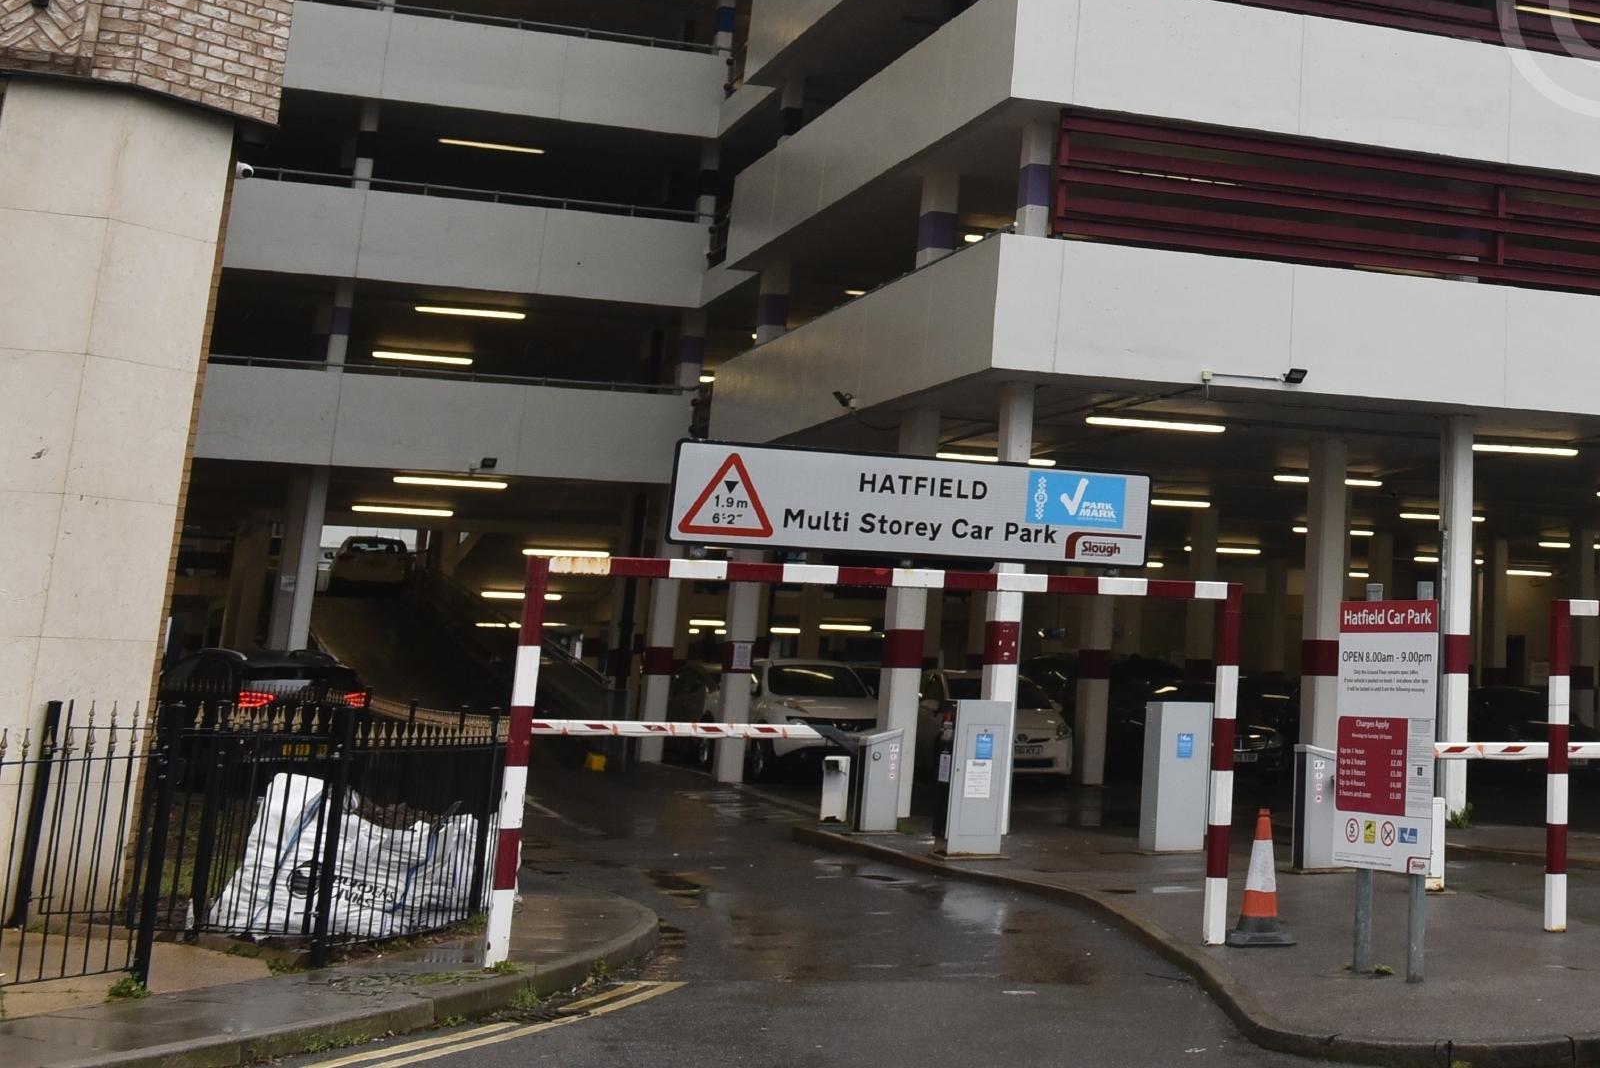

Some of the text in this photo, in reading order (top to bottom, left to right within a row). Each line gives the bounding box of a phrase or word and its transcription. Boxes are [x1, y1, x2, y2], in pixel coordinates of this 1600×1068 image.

[859, 472, 988, 500] HATFIELD
[1079, 508, 1116, 518] MARK
[1082, 502, 1113, 510] PARK
[783, 508, 1058, 544] Multi Storey Car Park
[1082, 540, 1120, 557] Slough
[1344, 608, 1432, 626] Hatfield Car Park
[1342, 651, 1364, 662] OPEN
[1366, 652, 1394, 662] 8.00am
[1400, 652, 1432, 666] 9.00pm
[1349, 823, 1355, 834] 5
